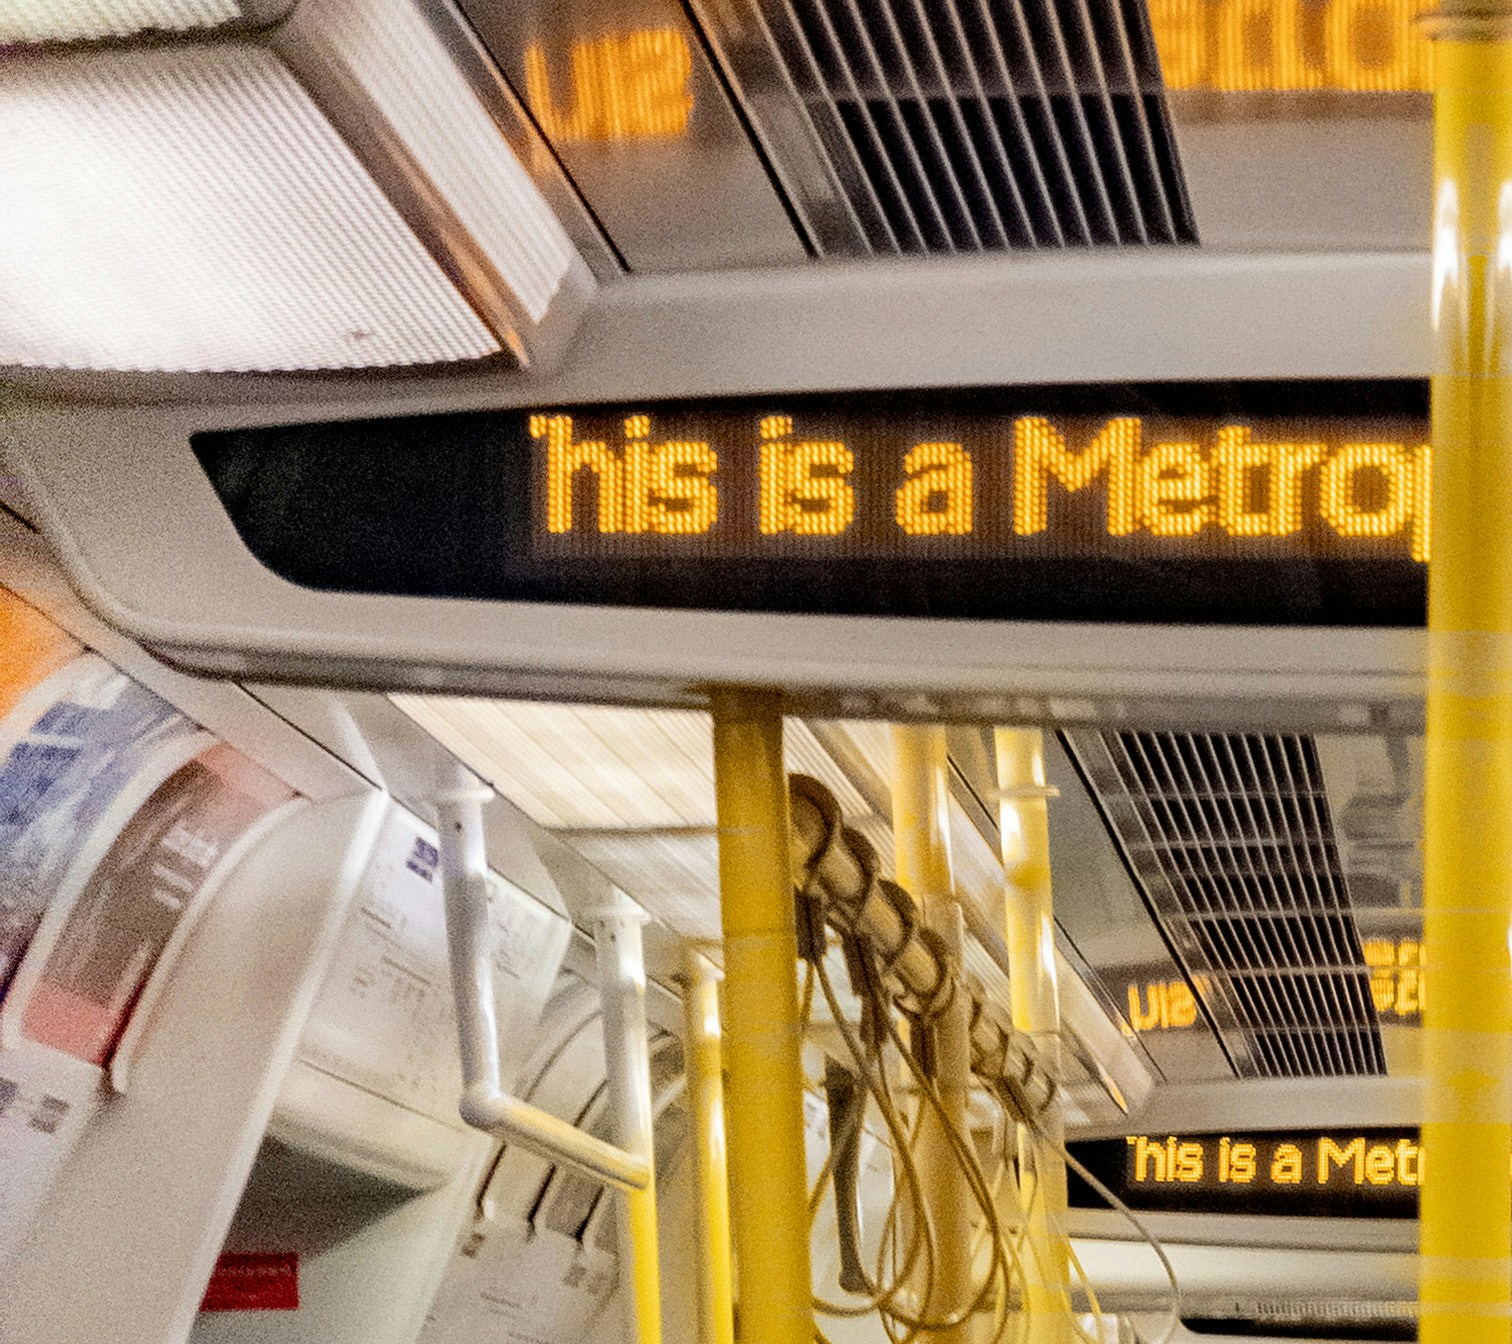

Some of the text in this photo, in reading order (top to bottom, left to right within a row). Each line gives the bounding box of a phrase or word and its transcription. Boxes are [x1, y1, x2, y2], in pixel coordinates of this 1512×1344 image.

[530, 415, 718, 534] his
[759, 415, 854, 535] is
[896, 441, 972, 536] a
[1126, 1135, 1204, 1183] his
[1219, 1136, 1257, 1184] is
[1270, 1143, 1303, 1184] a
